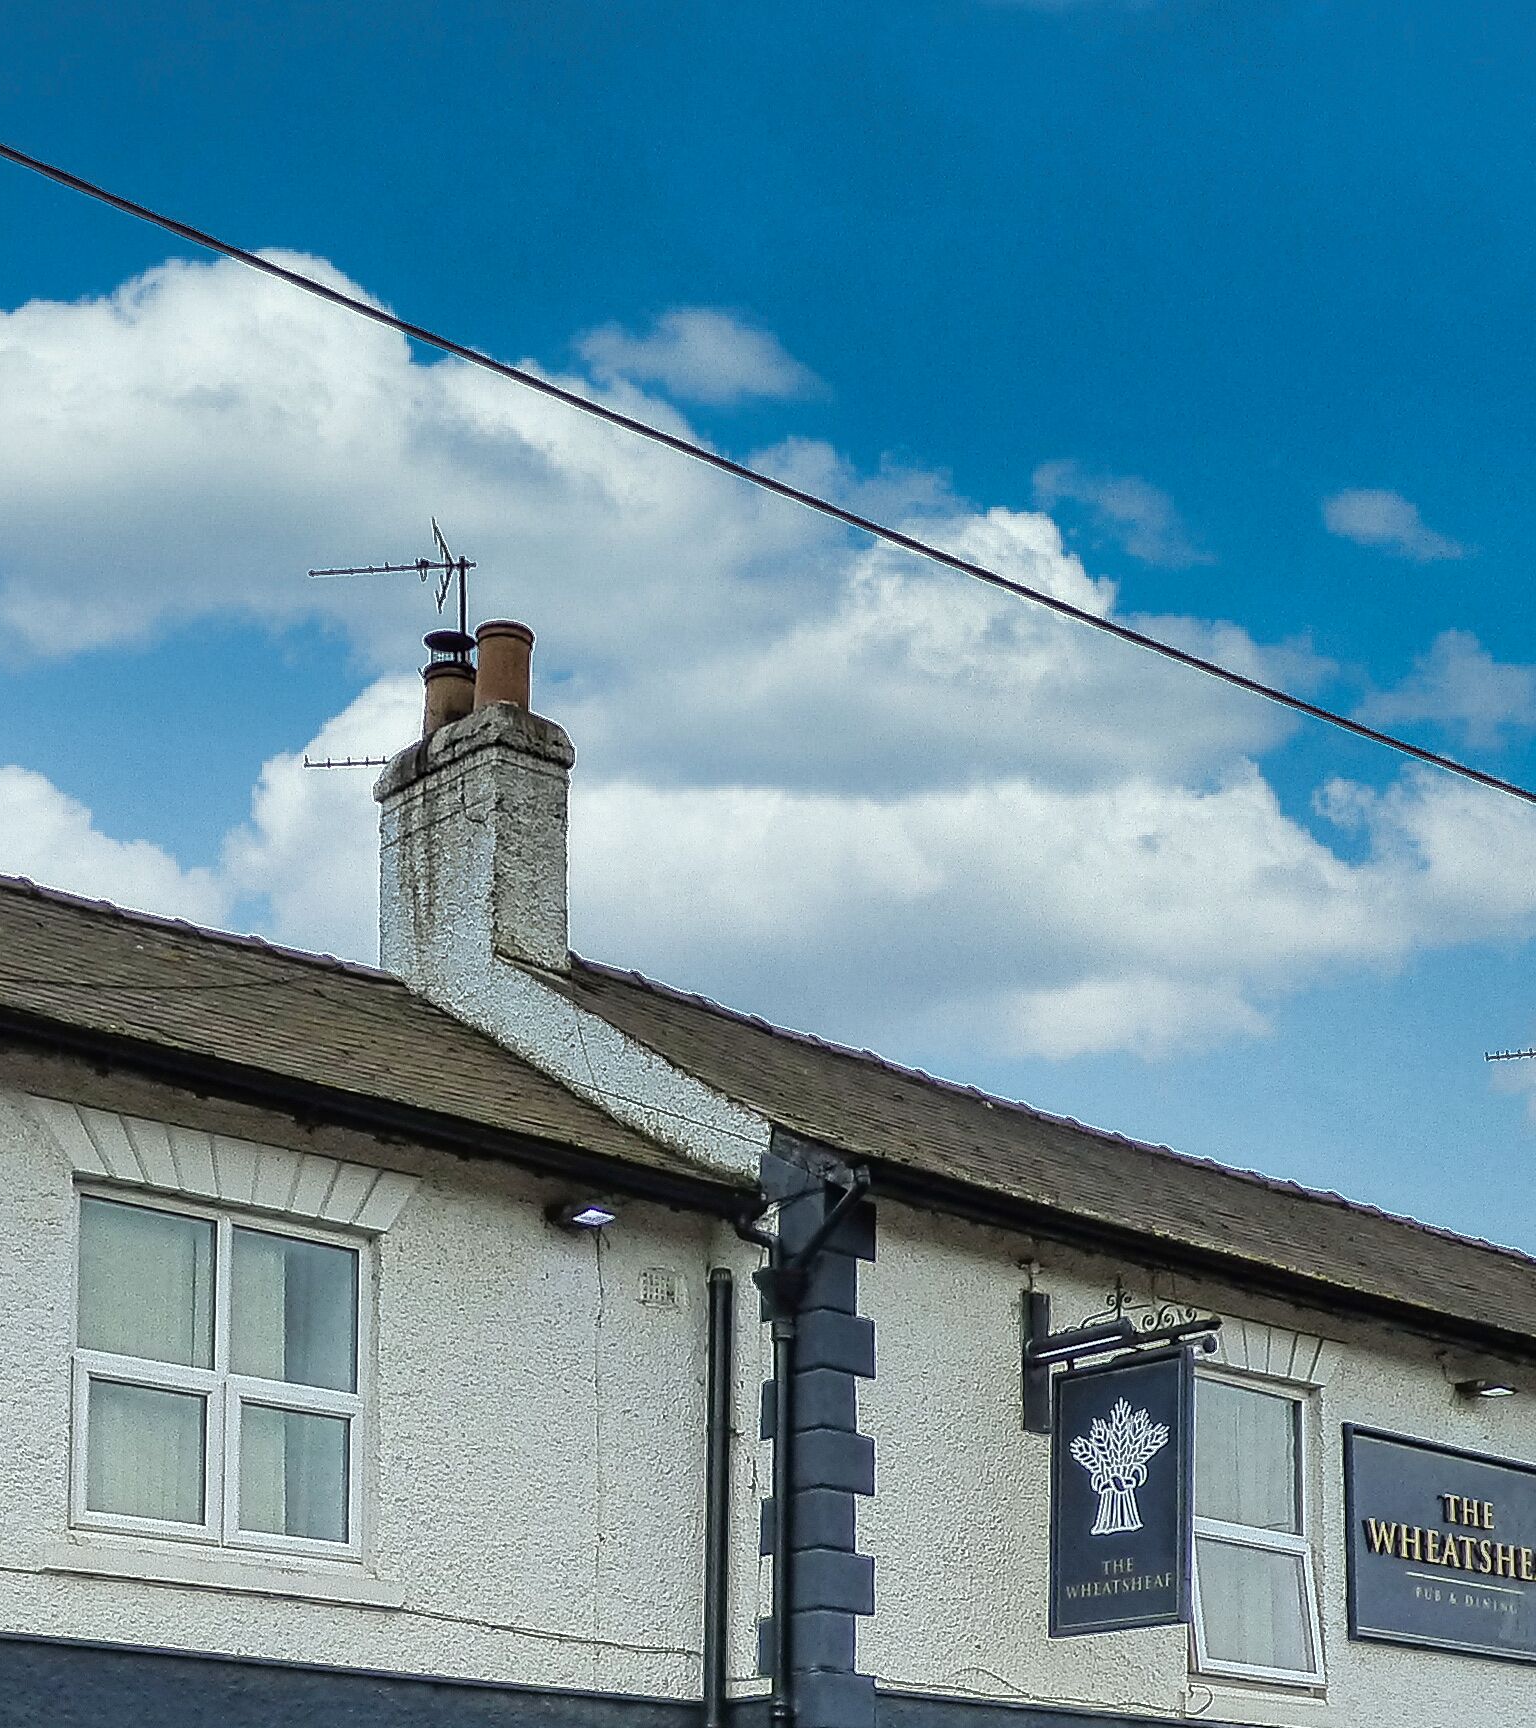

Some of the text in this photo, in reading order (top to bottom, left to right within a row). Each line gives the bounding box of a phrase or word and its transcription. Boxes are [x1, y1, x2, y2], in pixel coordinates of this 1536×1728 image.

[1444, 1493, 1495, 1529] THE
[1102, 1557, 1134, 1575] THE
[1066, 1572, 1172, 1599] WHEATSHEAF
[1415, 1586, 1519, 1615] PUB & DINING
